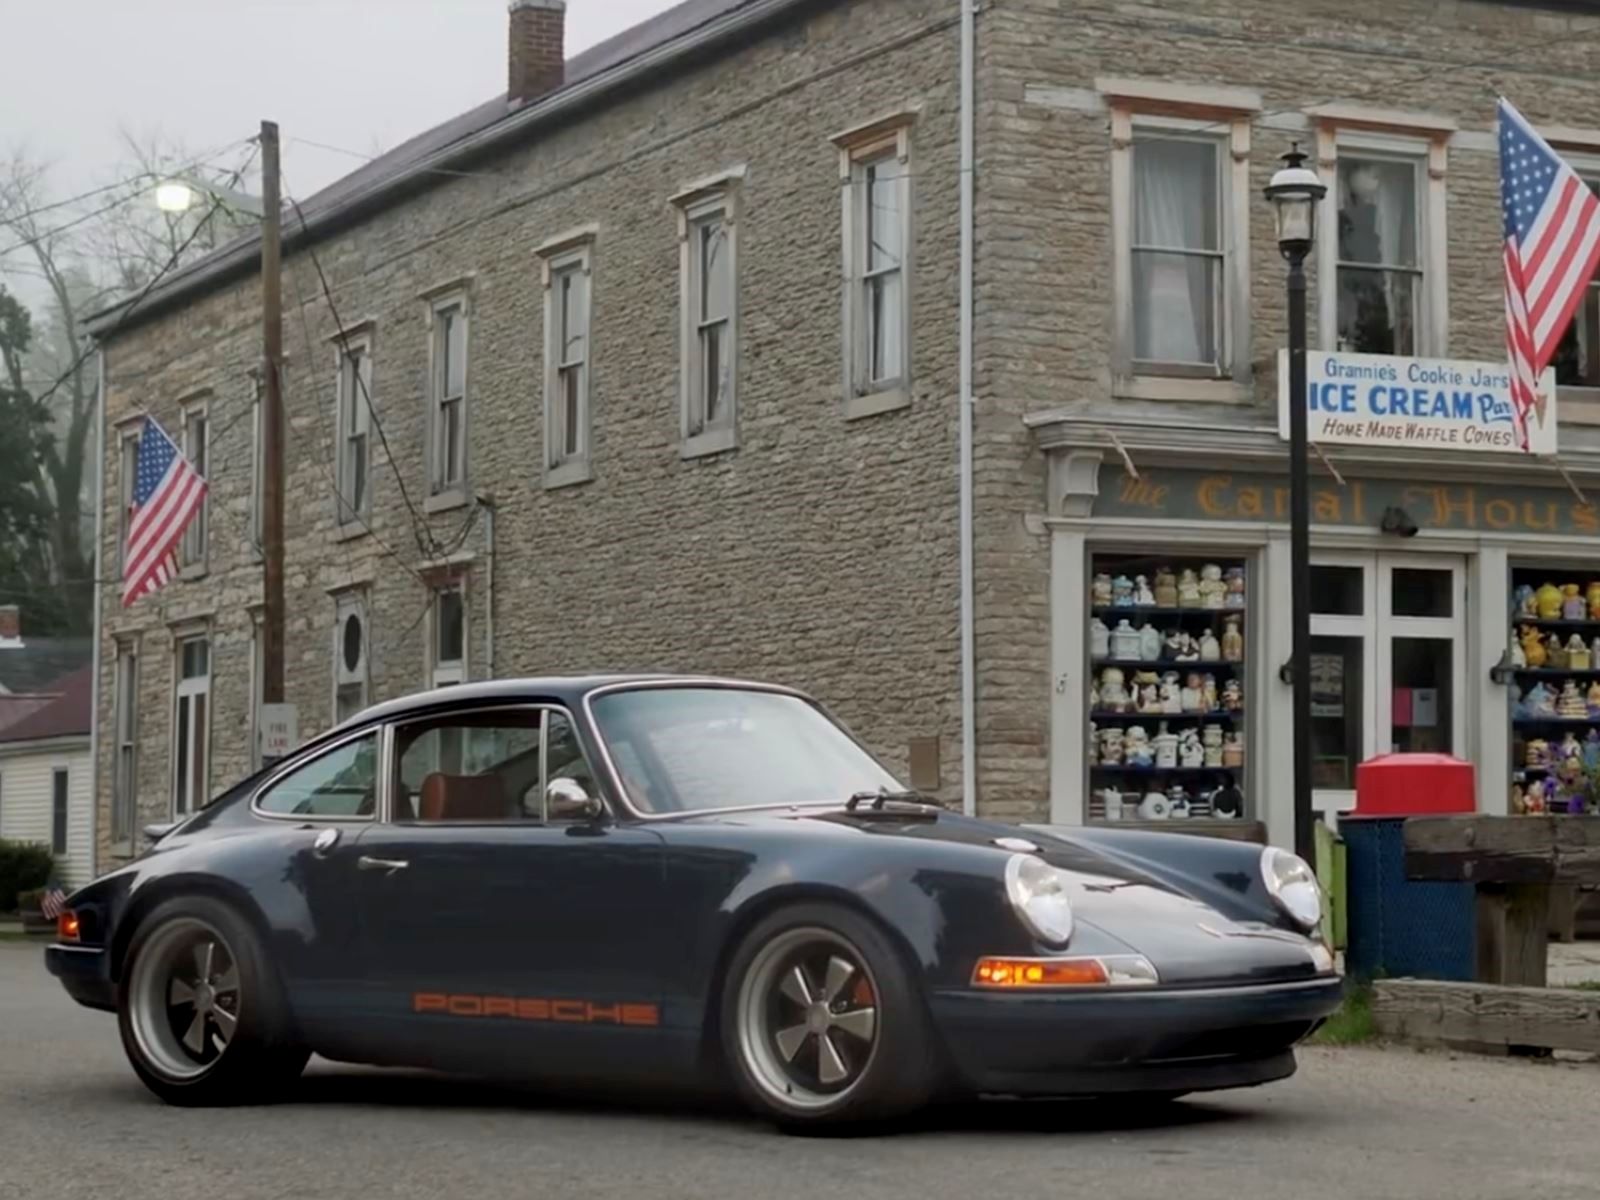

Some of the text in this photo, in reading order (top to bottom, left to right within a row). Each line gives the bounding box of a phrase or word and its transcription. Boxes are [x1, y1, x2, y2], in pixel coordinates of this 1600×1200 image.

[1324, 357, 1509, 389] Grannie's Cookie Jars
[1309, 382, 1356, 412] ICE
[1368, 384, 1473, 419] CREAM
[1322, 418, 1512, 446] HOME MADE WAFFLE CONES
[414, 993, 659, 1025] PORSCHE
